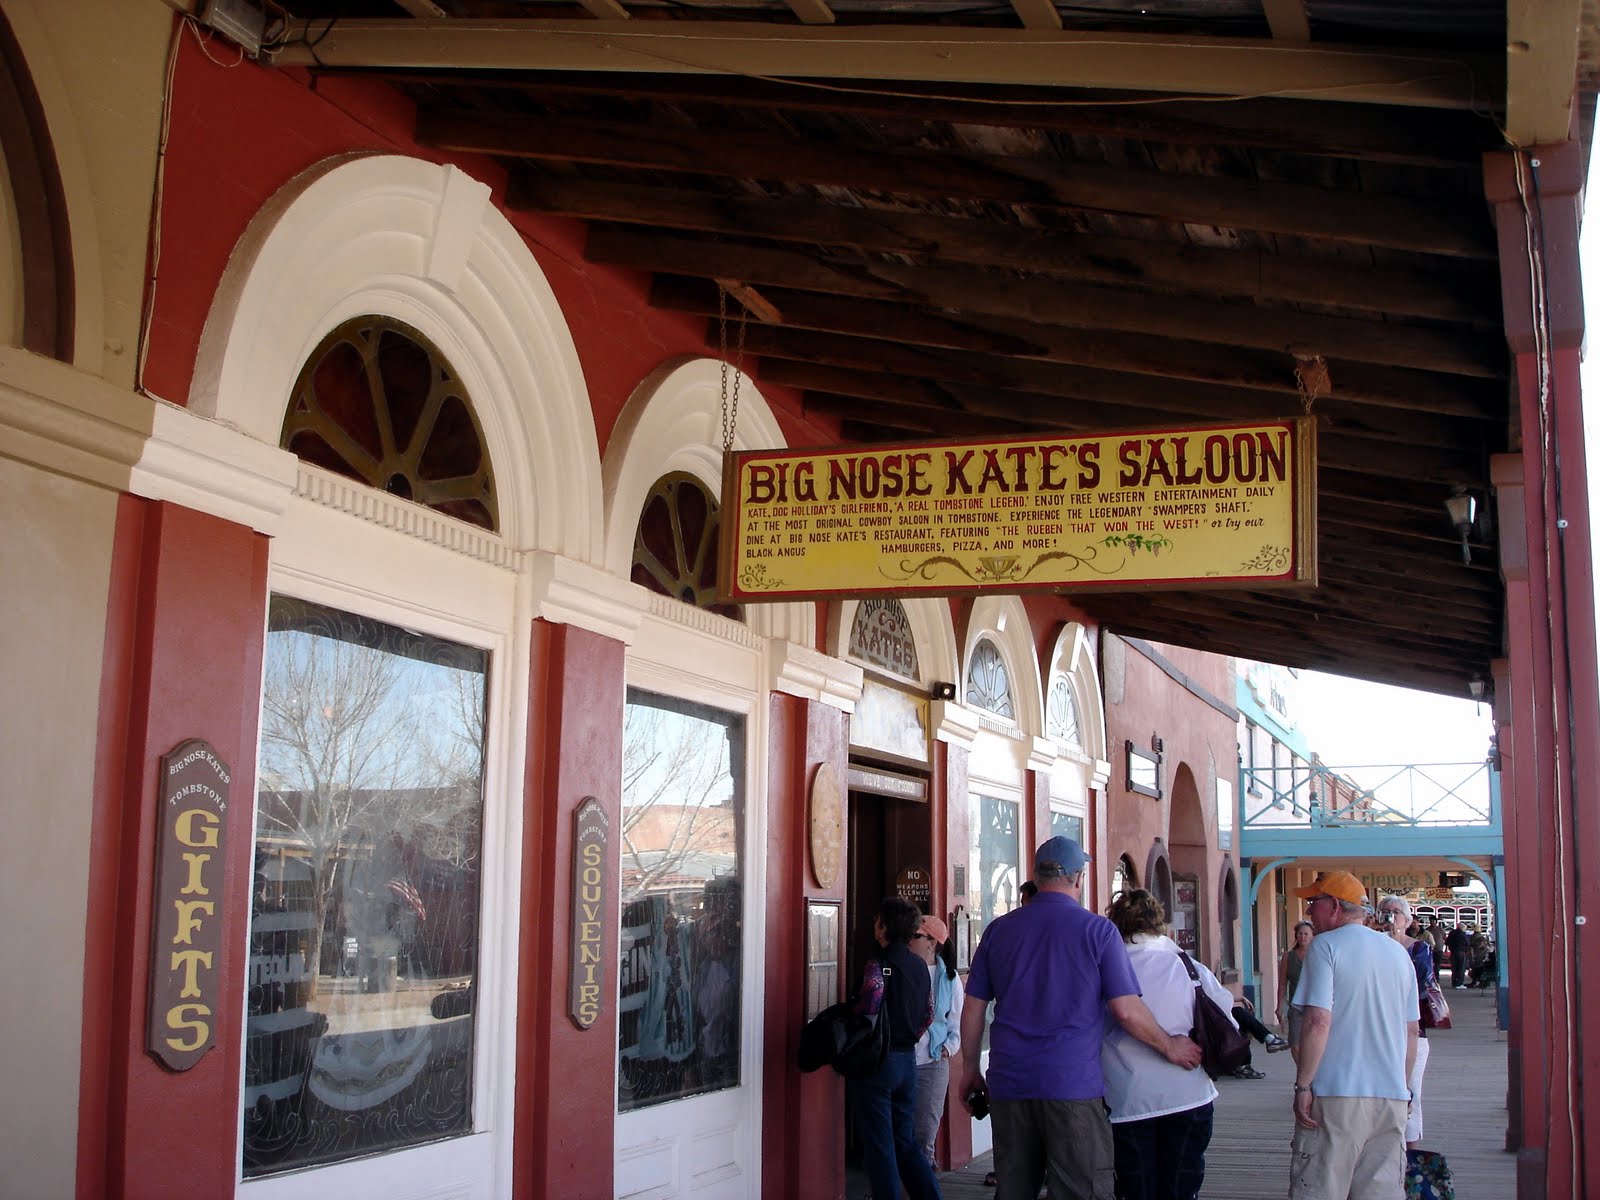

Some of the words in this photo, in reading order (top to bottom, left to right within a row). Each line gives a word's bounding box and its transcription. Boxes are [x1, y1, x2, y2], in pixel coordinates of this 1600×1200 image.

[745, 461, 819, 504] BIG
[828, 453, 933, 501] NOSE
[944, 443, 1101, 496] KATE'S
[1119, 431, 1288, 488] SALOON
[748, 507, 771, 519] KATE,
[773, 506, 788, 517] DOC
[792, 504, 836, 516] HOLLIDAY'S
[841, 502, 892, 514] GIRLFRIEND,
[908, 501, 928, 511] REAL
[934, 498, 983, 510] TOMBSTONE
[1035, 494, 1065, 506] ENJOY
[1071, 493, 1092, 504] FREE
[1098, 491, 1145, 503] WESTERN
[1154, 487, 1238, 501] ENTERTAINMENT
[1246, 486, 1275, 497] DAILY
[746, 535, 764, 545] DINE
[770, 534, 781, 544] AT
[790, 533, 802, 543] BIG
[809, 532, 831, 543] NOSE
[836, 531, 867, 541] KATE'S
[940, 526, 989, 538] FEATURING
[1026, 524, 1062, 535] RUEBEN
[1104, 521, 1128, 532] WON
[1136, 520, 1155, 531] THE
[1211, 519, 1222, 528] or
[1225, 519, 1241, 531] try
[1245, 518, 1264, 527] our
[747, 522, 758, 532] AT
[764, 520, 780, 531] THE
[785, 520, 808, 530] MOST
[816, 518, 853, 529] ORIGINAL
[859, 516, 892, 527] COWBOY
[899, 514, 929, 525] SALOON
[933, 514, 943, 524] IN
[948, 512, 1002, 524] TOMBSTONE.
[1010, 509, 1060, 521] EXPERIENCE
[1067, 508, 1082, 519] THE
[1089, 506, 1142, 518] LEGENDARY
[746, 549, 773, 558] BLACK
[777, 547, 806, 557] ANGUS
[881, 542, 945, 554] HAMBURGERS,
[993, 540, 1013, 550] AND
[169, 761, 185, 775] BIG
[183, 750, 206, 766] NOSE
[169, 784, 227, 812] TOMBSTONE
[907, 870, 920, 880] NO
[1354, 872, 1419, 887] rlene's
[166, 808, 220, 1051] GIFTS
[579, 844, 601, 1025] SOUVENIRS
